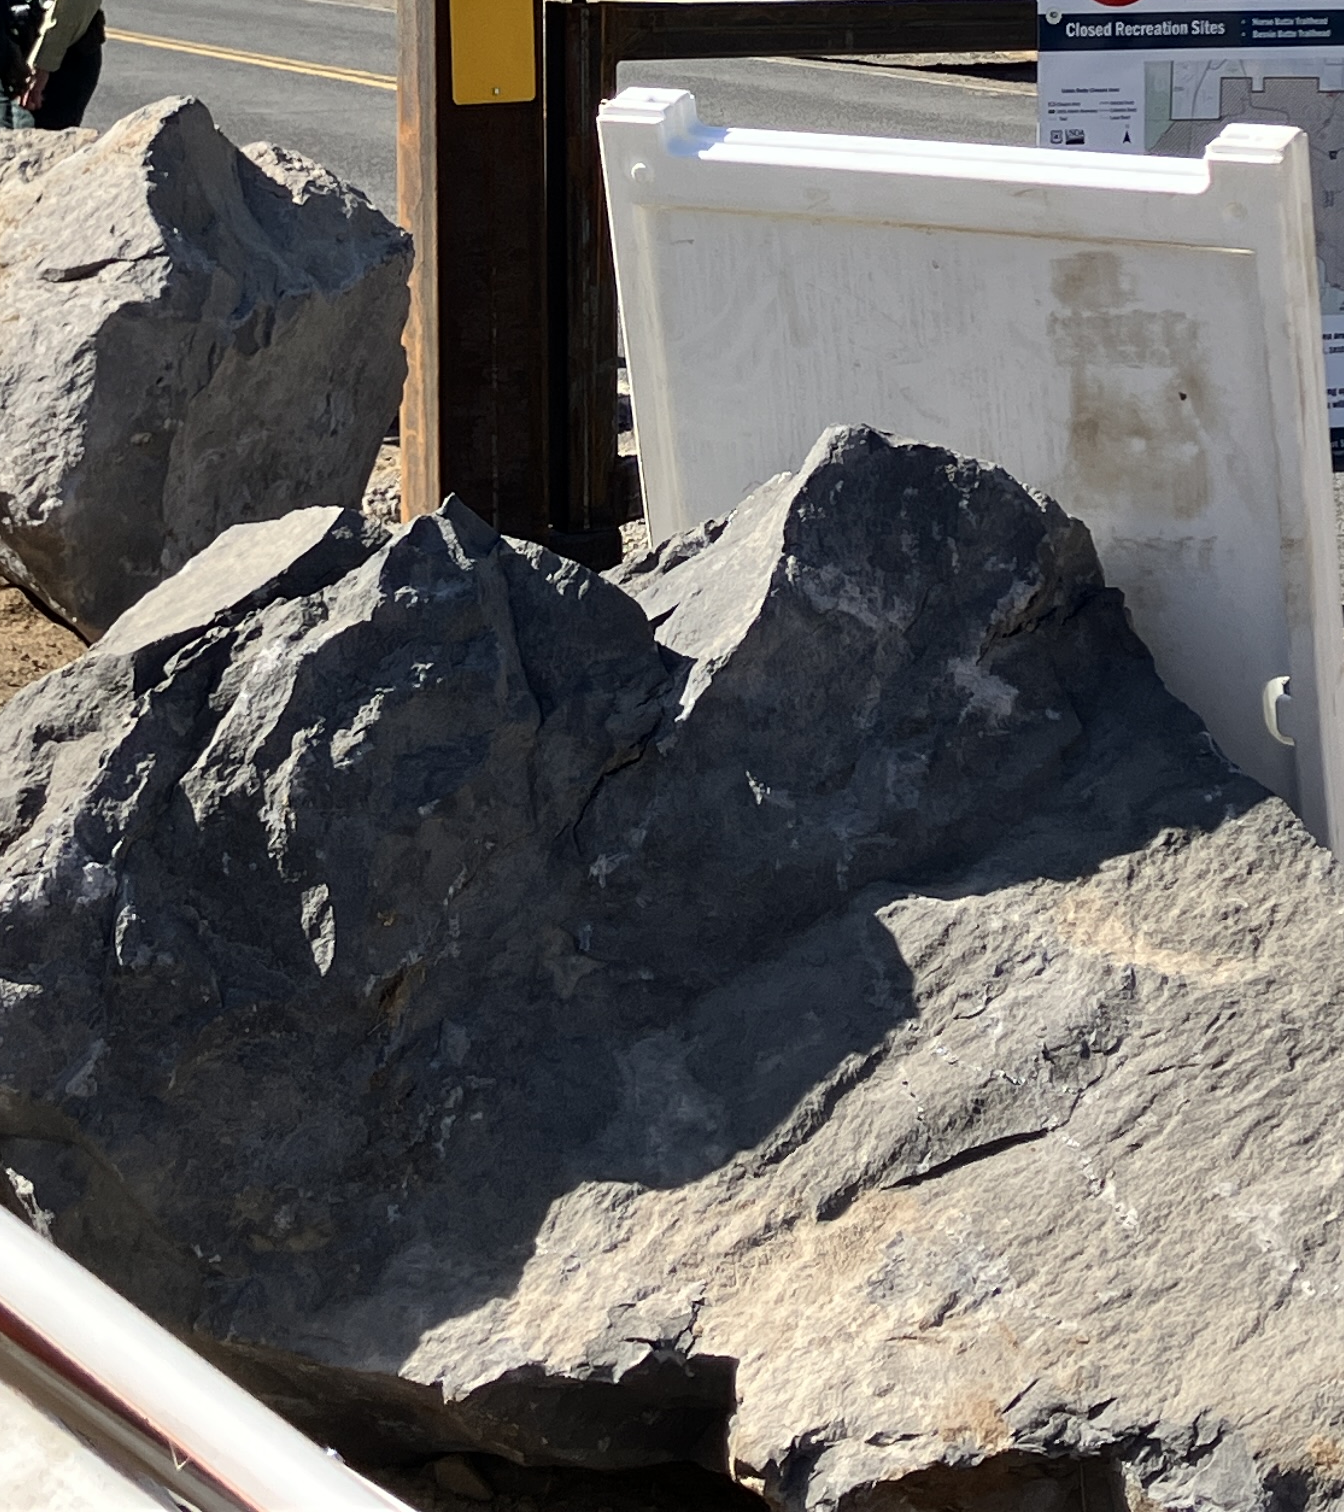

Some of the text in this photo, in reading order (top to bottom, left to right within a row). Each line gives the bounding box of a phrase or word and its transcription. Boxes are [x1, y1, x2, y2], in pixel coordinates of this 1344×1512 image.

[1065, 19, 1225, 38] Closed Recreation Sites
